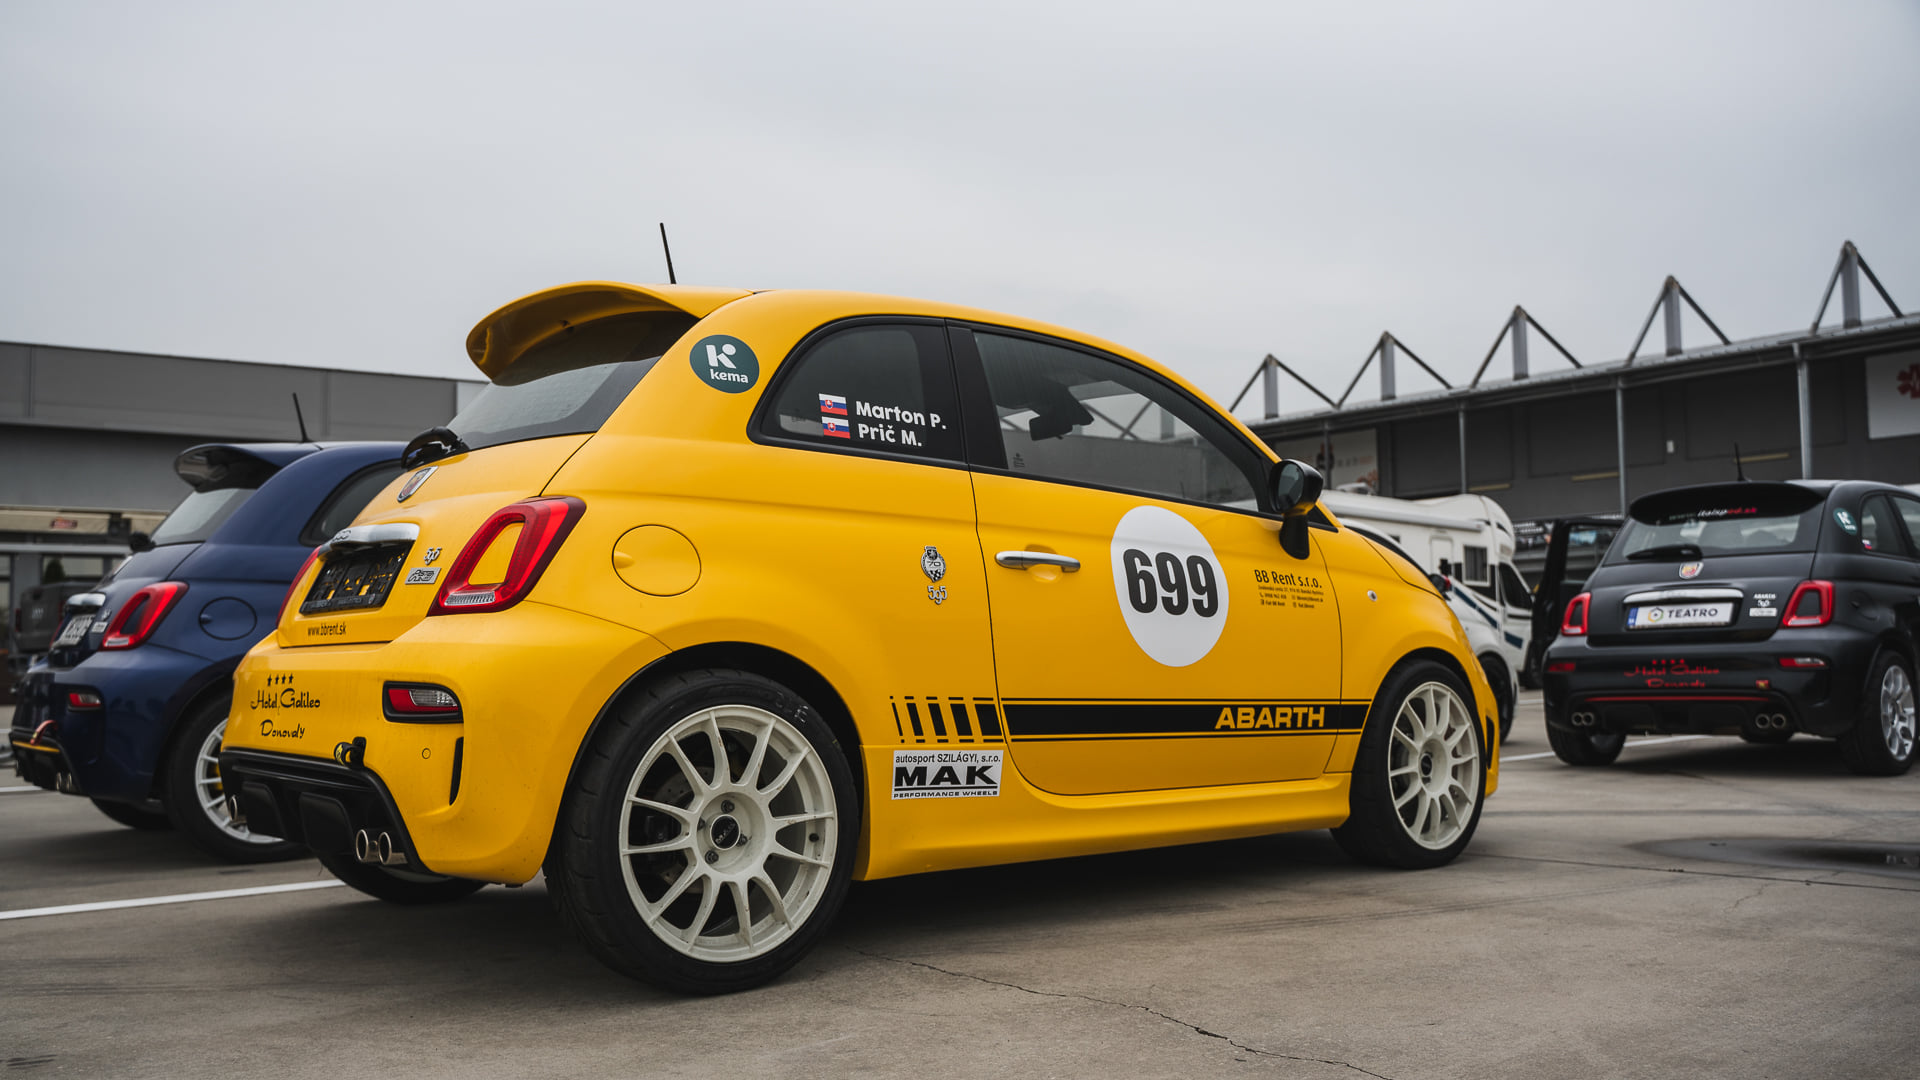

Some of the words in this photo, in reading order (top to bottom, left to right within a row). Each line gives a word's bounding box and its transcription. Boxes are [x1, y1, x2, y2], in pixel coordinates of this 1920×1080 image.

[710, 368, 749, 384] kema
[856, 401, 926, 426] Marton
[930, 413, 947, 430] P.
[858, 423, 896, 443] Prič
[901, 429, 922, 447] M.
[1122, 548, 1219, 618] 699
[1254, 569, 1270, 583] BB
[1271, 571, 1296, 586] Rent
[1298, 576, 1322, 588] s.r.o.
[1667, 608, 1718, 619] TEATRO
[307, 621, 346, 636] www.bbrent.sk
[250, 689, 278, 710] Hotel
[280, 687, 321, 709] Galileo
[1214, 706, 1325, 730] ABARTH
[895, 754, 935, 765] autosport
[937, 751, 979, 764] SZILÁGYI,
[981, 755, 1001, 763] s.r.o.
[894, 765, 998, 787] MAK
